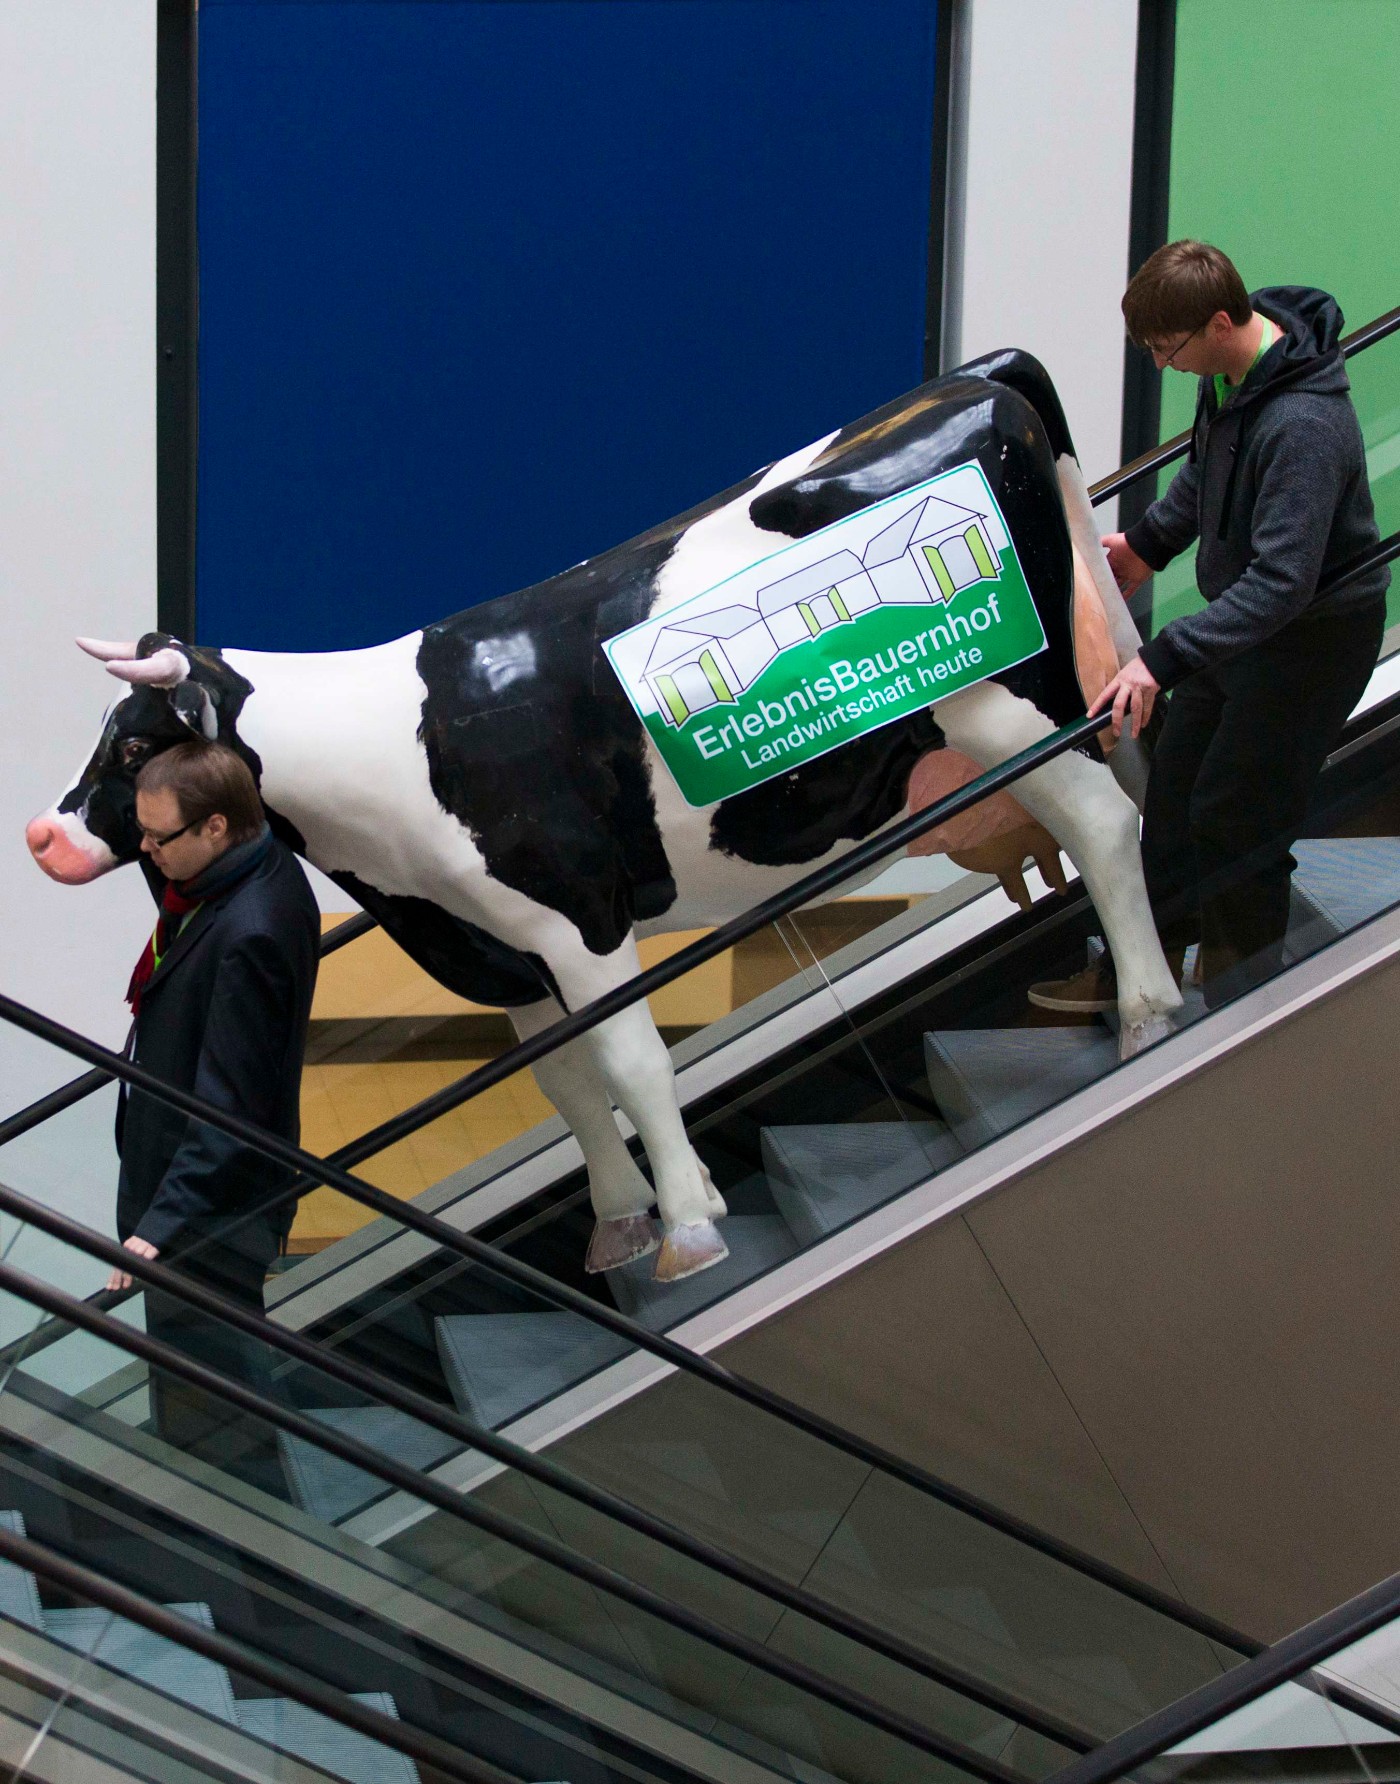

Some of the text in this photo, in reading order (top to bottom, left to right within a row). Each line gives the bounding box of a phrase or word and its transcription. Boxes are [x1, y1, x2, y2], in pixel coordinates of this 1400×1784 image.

[692, 593, 1003, 760] ErlebnisBauernhof
[741, 646, 984, 769] Landwirtschaft heute
